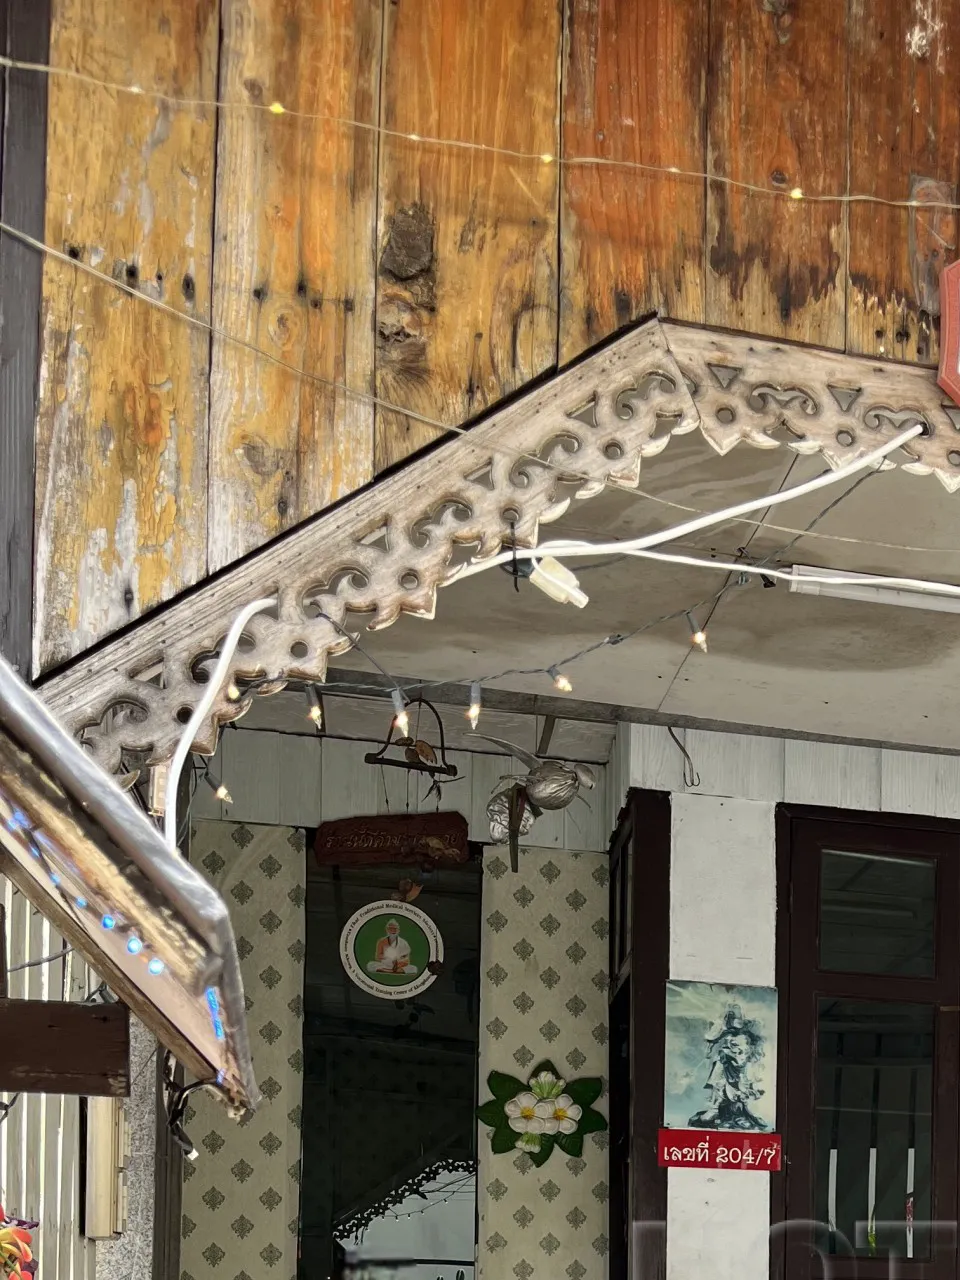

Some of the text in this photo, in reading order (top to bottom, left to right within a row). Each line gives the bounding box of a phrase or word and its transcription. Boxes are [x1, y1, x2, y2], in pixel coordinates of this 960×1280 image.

[663, 1136, 776, 1165] เลขที่ 204/7
